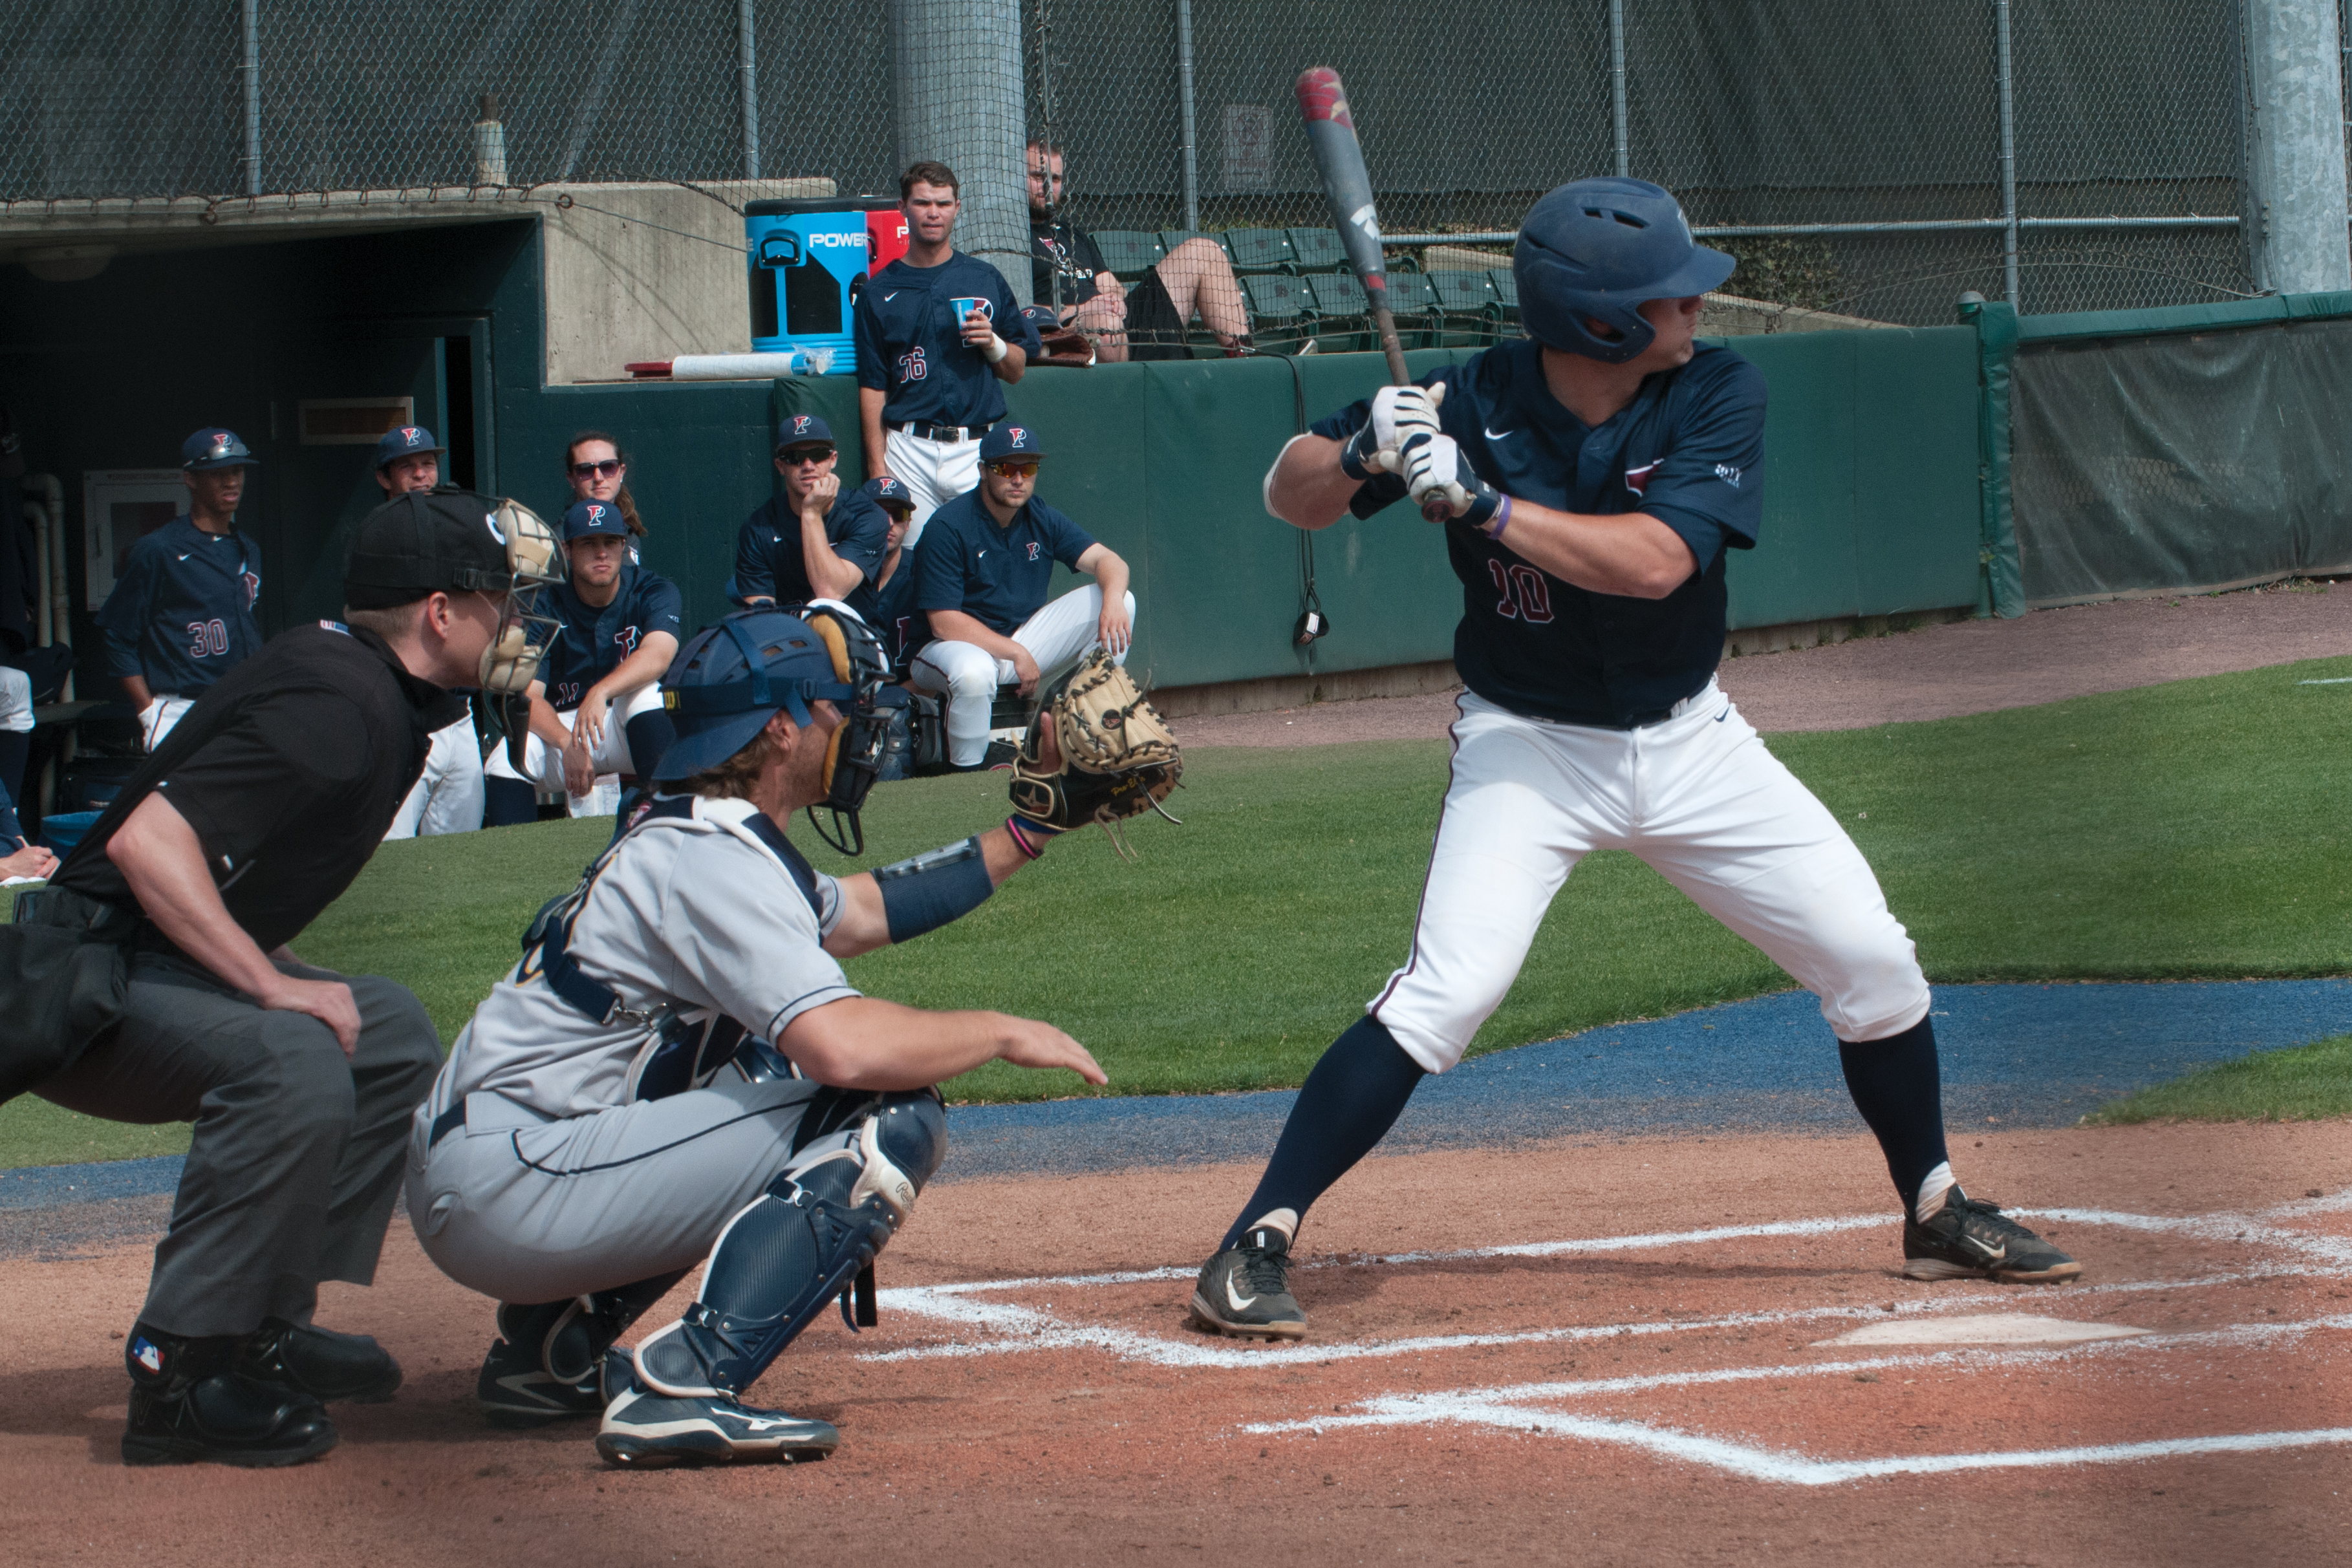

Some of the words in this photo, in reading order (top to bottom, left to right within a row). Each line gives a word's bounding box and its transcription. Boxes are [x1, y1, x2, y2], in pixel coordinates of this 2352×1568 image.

[794, 416, 812, 435] P
[402, 428, 420, 446] P
[1009, 428, 1027, 447] P
[880, 478, 897, 495] P
[587, 505, 606, 526] P
[1026, 542, 1041, 561] P
[1488, 558, 1555, 623] 10
[188, 619, 229, 658] 30
